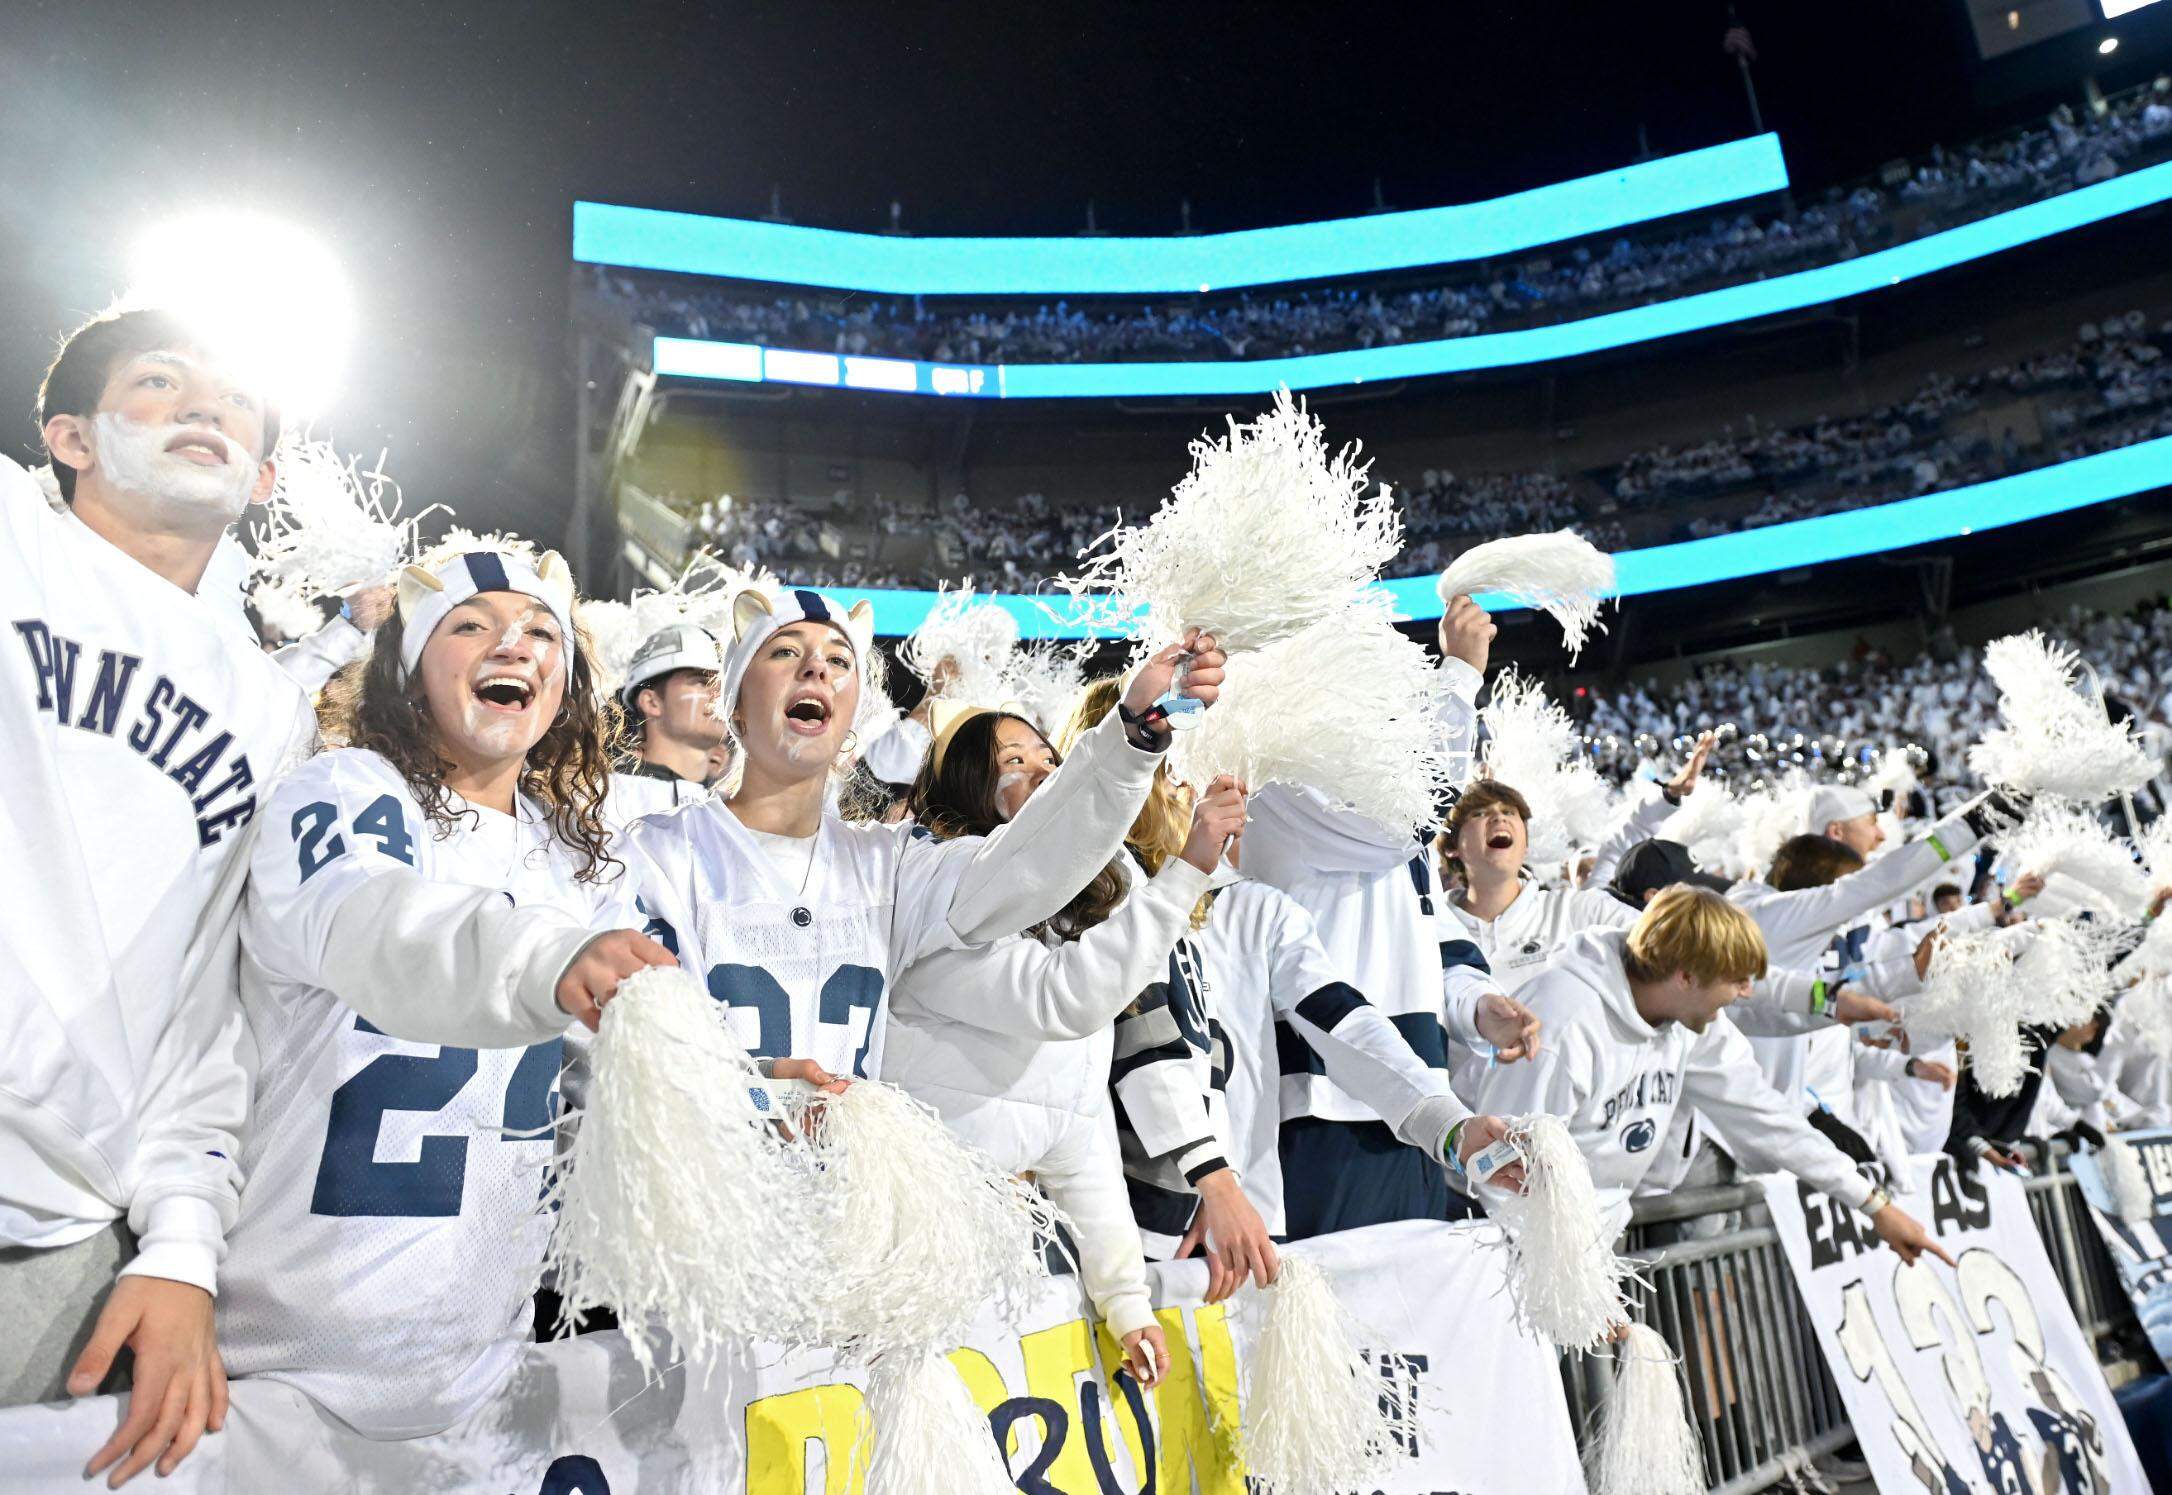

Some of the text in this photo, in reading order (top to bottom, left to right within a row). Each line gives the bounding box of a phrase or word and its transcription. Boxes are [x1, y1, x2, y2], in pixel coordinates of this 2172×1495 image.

[127, 673, 257, 854] STATE
[290, 793, 415, 886] 24
[1931, 1157, 1992, 1238] AS
